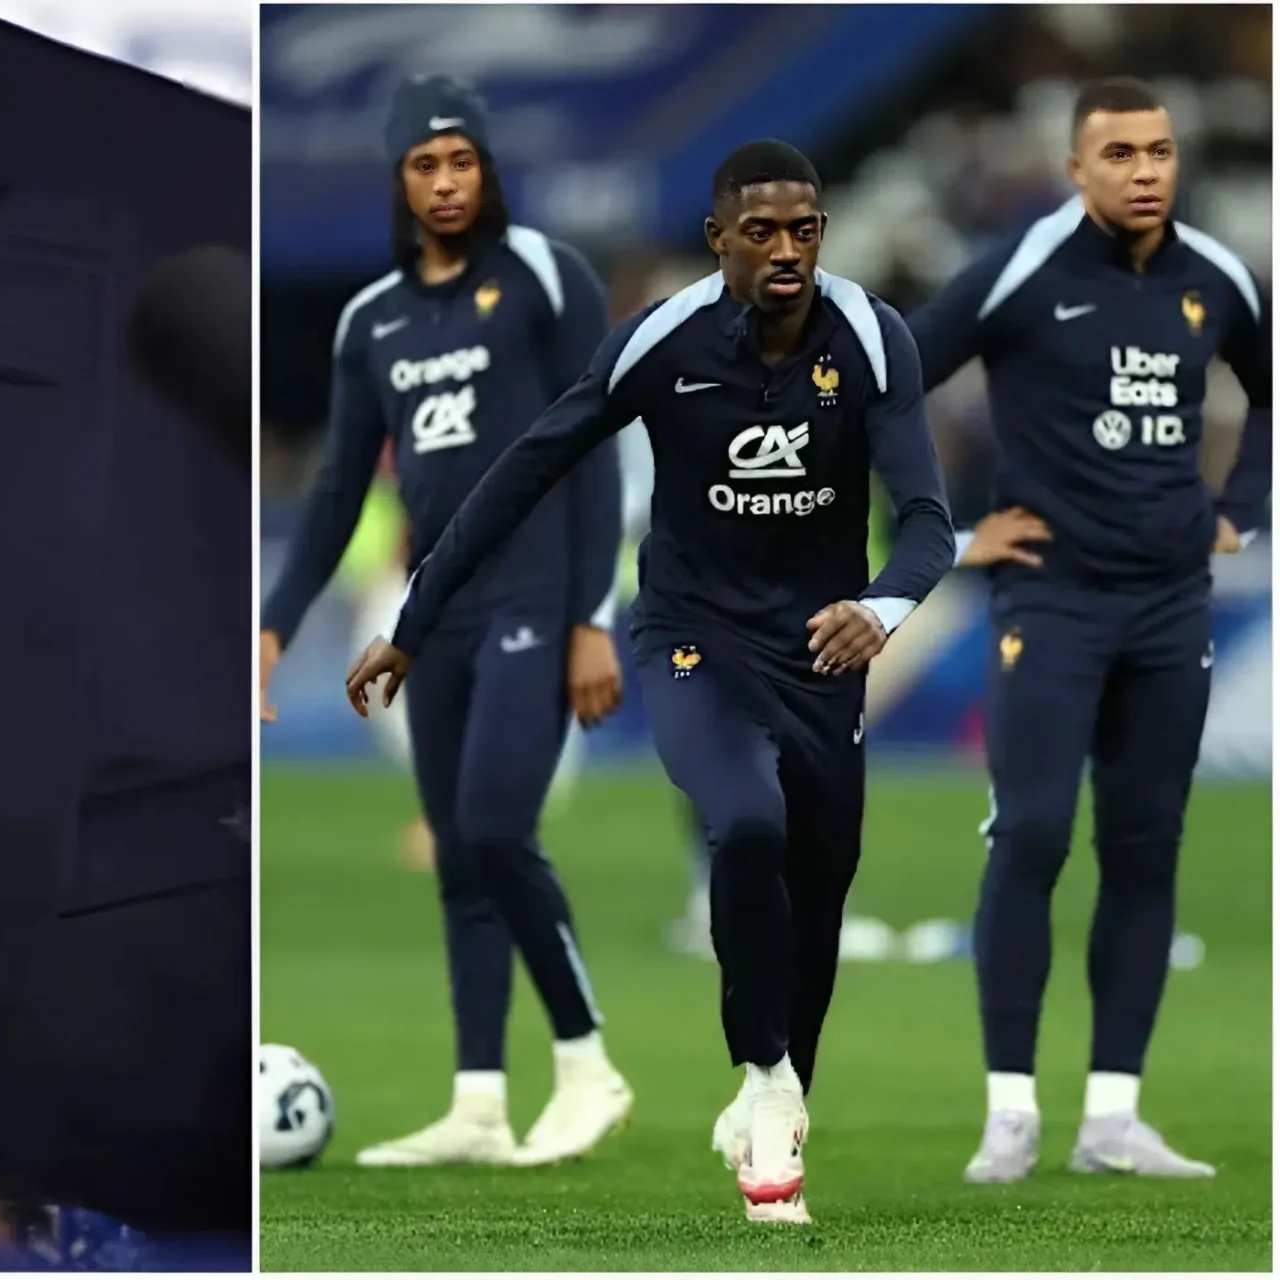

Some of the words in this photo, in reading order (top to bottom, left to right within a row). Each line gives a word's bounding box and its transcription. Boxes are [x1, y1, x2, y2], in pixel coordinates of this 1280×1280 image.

[390, 345, 490, 392] Orange
[1110, 346, 1180, 377] Uber
[1110, 375, 1178, 407] Eats
[708, 483, 836, 517] Orange
